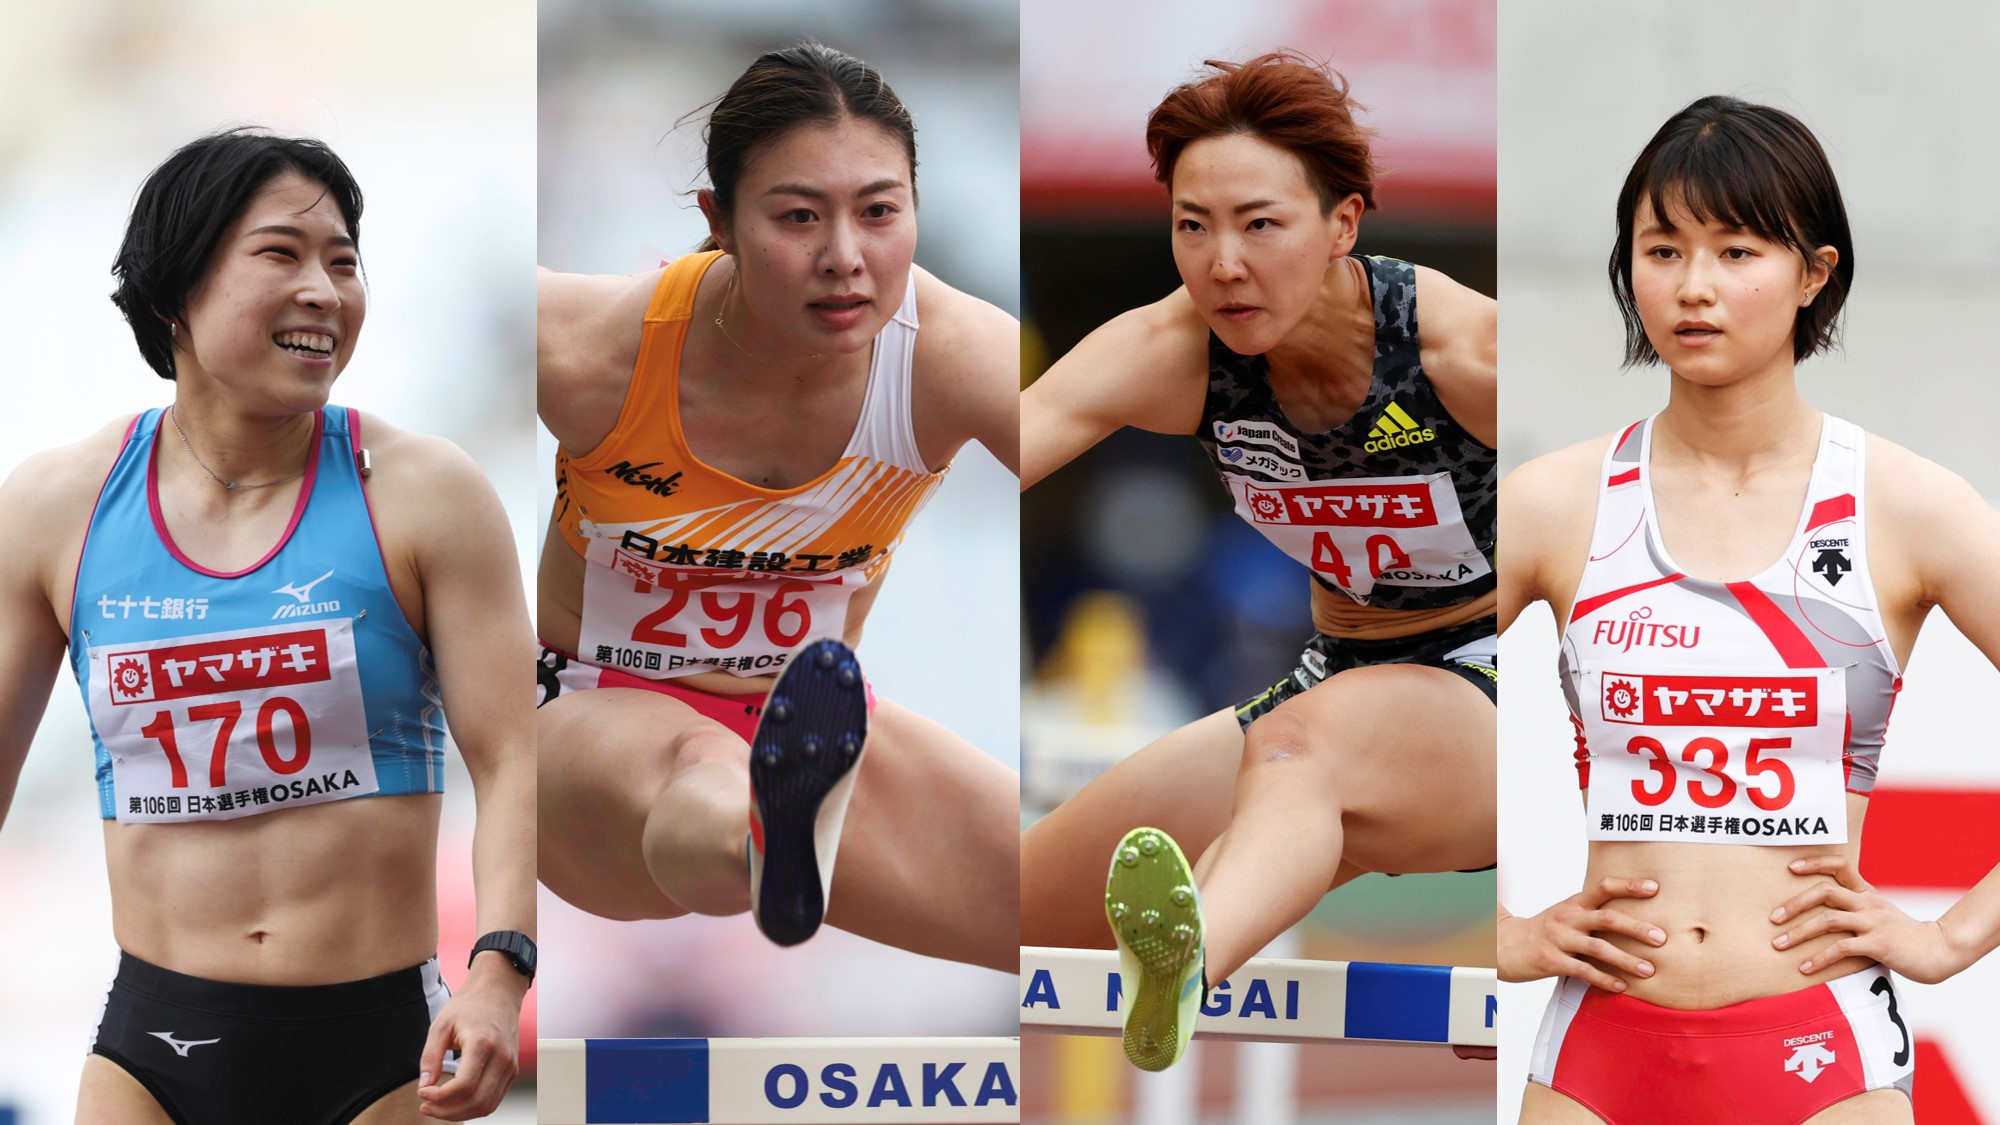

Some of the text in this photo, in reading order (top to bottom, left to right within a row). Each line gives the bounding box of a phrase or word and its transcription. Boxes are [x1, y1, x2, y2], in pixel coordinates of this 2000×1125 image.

[1363, 427, 1435, 453] adidas
[1245, 456, 1302, 478] メガテック
[1292, 494, 1424, 519] ヤマザキ
[1809, 538, 1849, 549] DESCENTE
[97, 594, 209, 621] 七十七銀行
[631, 580, 815, 650] 296
[1592, 620, 1701, 653] FUJITSU
[161, 643, 318, 688] ヤマザキ
[595, 645, 662, 671] 第106回
[1653, 687, 1806, 717] ヤマザキ
[141, 696, 312, 789] 170
[1626, 736, 1795, 811] 335
[128, 796, 182, 815] 第106回
[1600, 814, 1653, 832] 第106回
[1869, 976, 1909, 1067] 3
[1783, 1030, 1835, 1047] DESCENTE
[763, 1062, 1018, 1109] OSAKA
